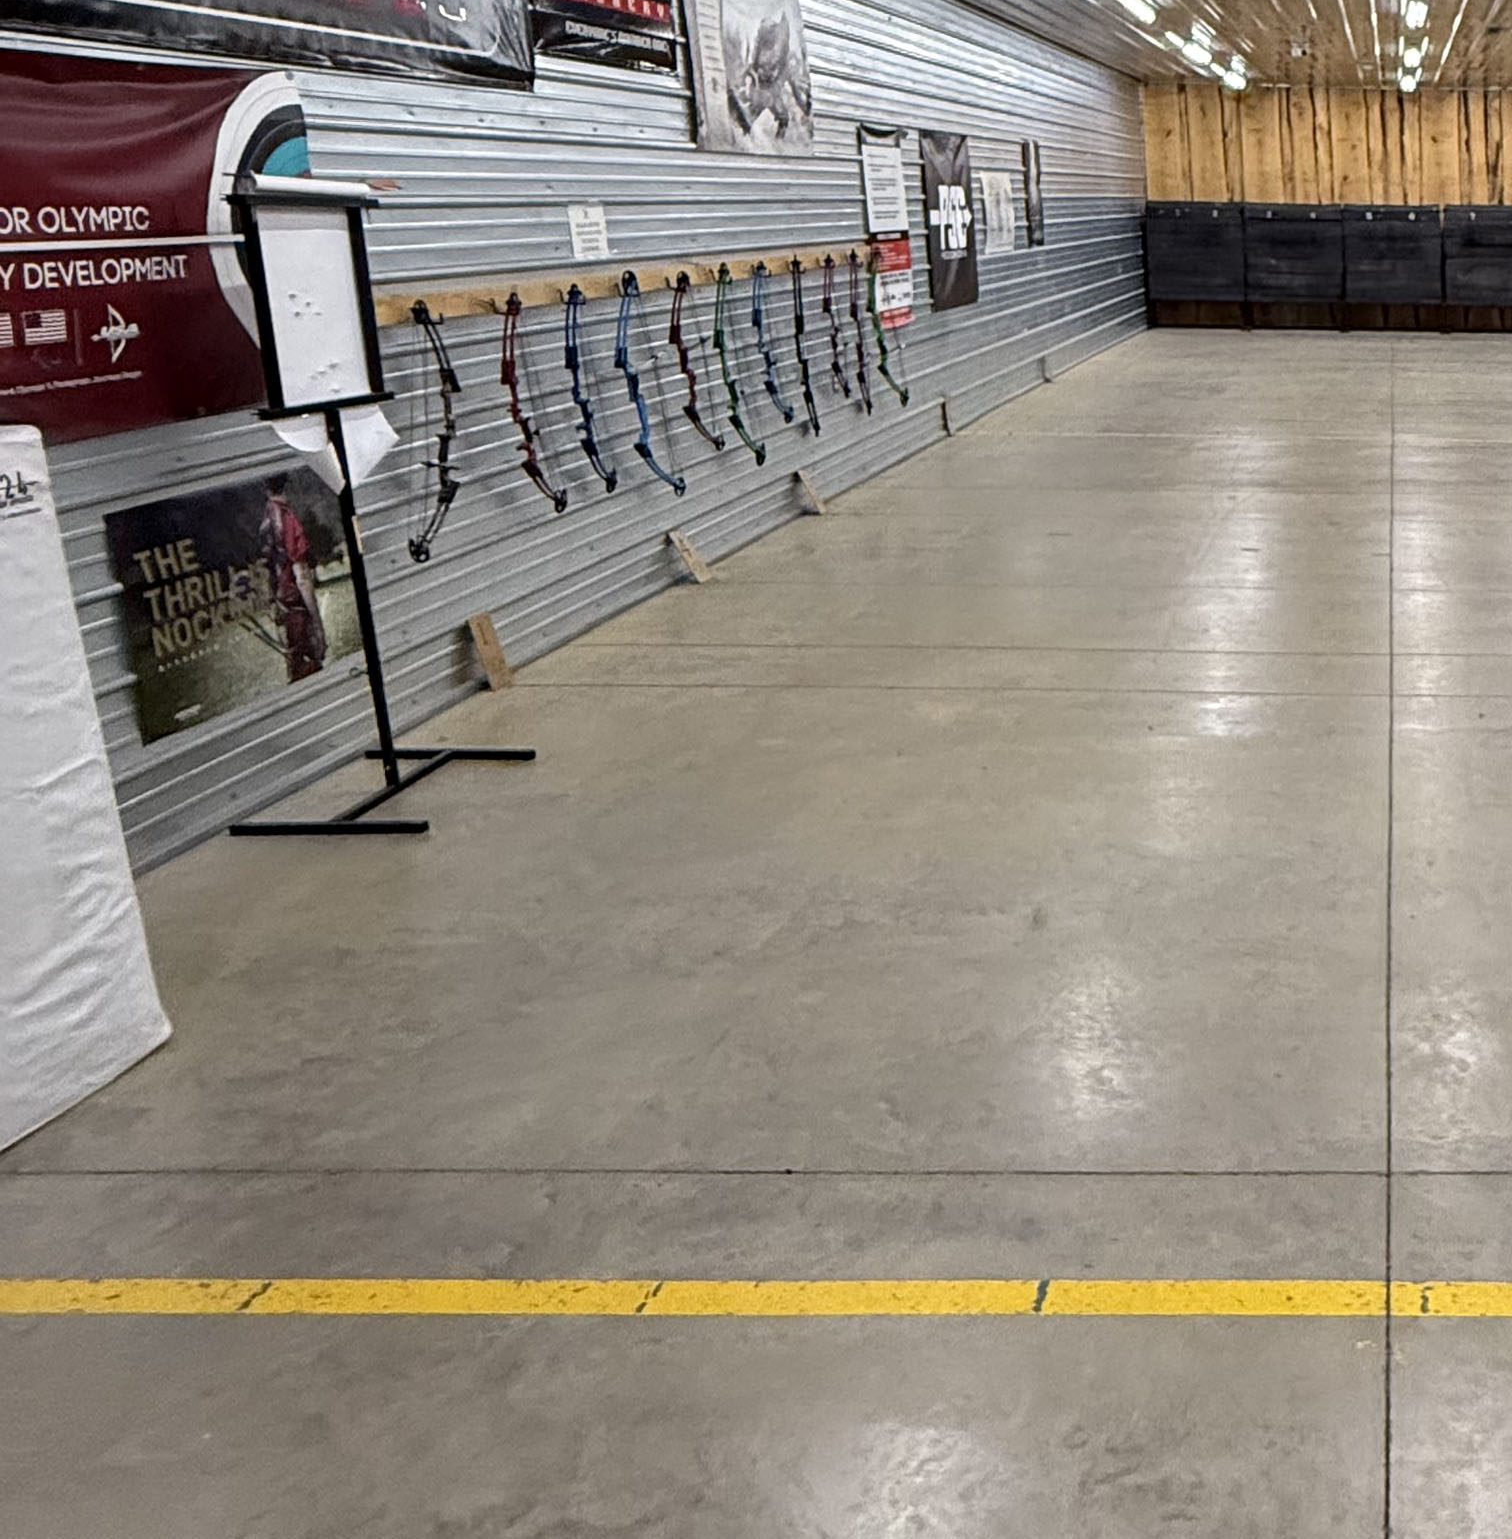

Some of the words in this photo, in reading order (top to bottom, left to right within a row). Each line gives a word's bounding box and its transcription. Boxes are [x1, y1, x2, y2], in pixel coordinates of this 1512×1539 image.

[37, 206, 150, 234] OLYMPIC
[23, 255, 188, 290] DEVELOPMENT
[133, 538, 200, 583] THE
